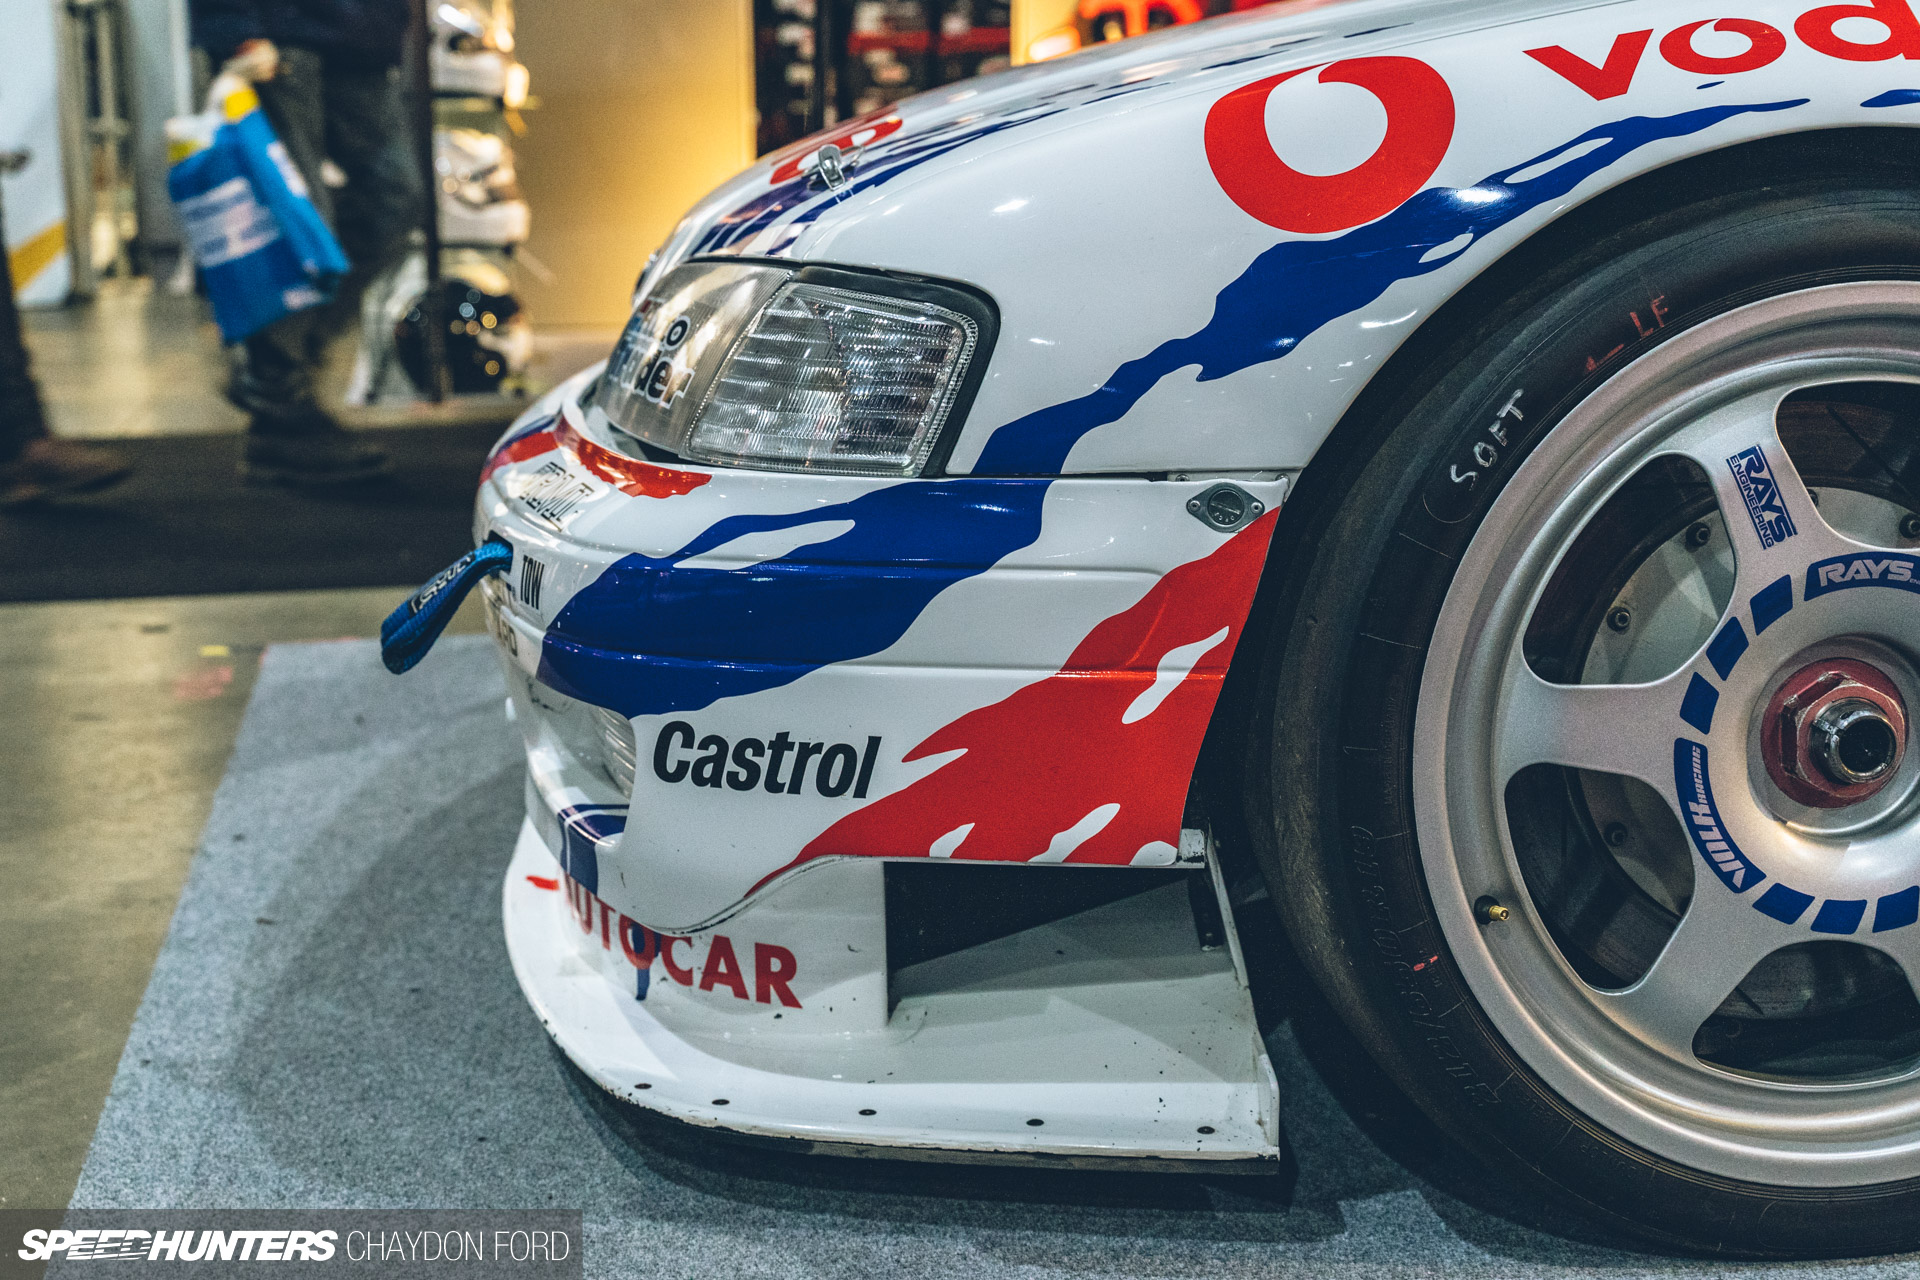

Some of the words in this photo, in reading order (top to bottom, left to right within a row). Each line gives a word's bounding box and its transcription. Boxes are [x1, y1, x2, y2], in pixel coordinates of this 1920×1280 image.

[1450, 388, 1524, 491] SOFT
[1729, 455, 1774, 549] ENGINEERING
[1738, 445, 1794, 543] RAYS
[520, 555, 545, 610] TOW
[1818, 559, 1914, 587] RAYS
[653, 720, 882, 799] Castrol
[1688, 801, 1746, 889] VOLK
